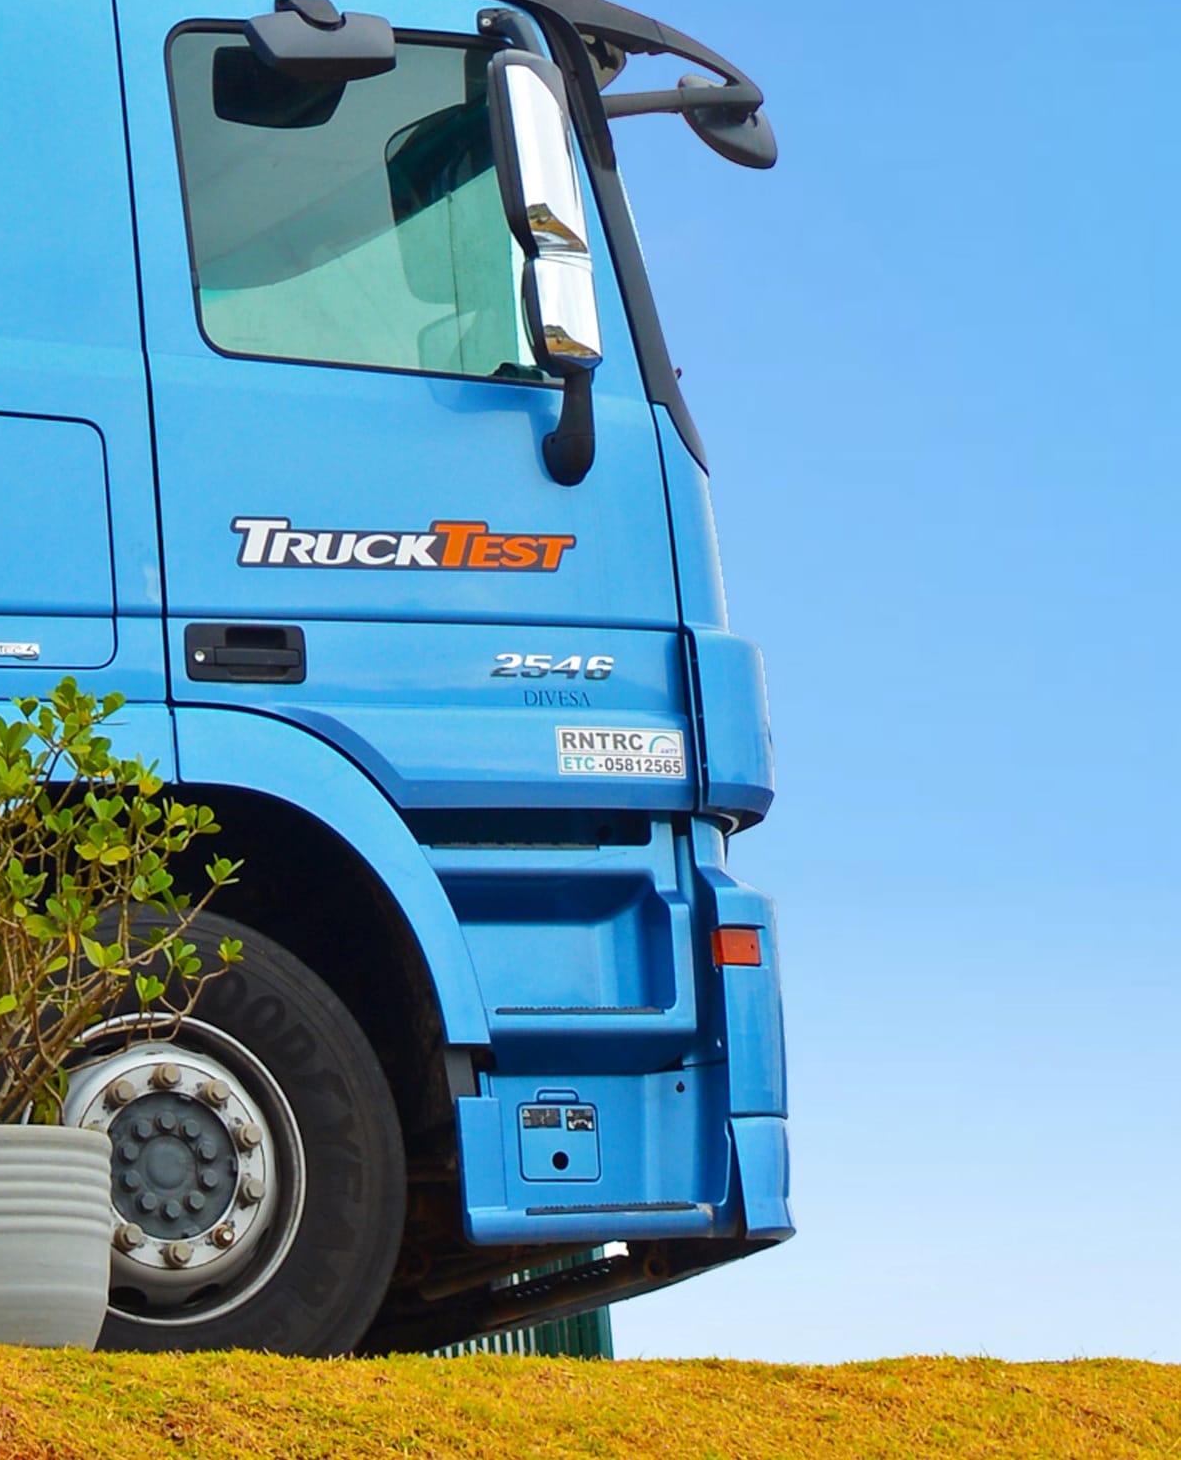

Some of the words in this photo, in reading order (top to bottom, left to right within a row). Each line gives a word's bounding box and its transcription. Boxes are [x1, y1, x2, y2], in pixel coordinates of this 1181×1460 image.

[234, 519, 575, 570] TRUCKTEST
[490, 652, 615, 681] 2546
[523, 689, 592, 708] DIVESA
[562, 731, 644, 751] RNTRC
